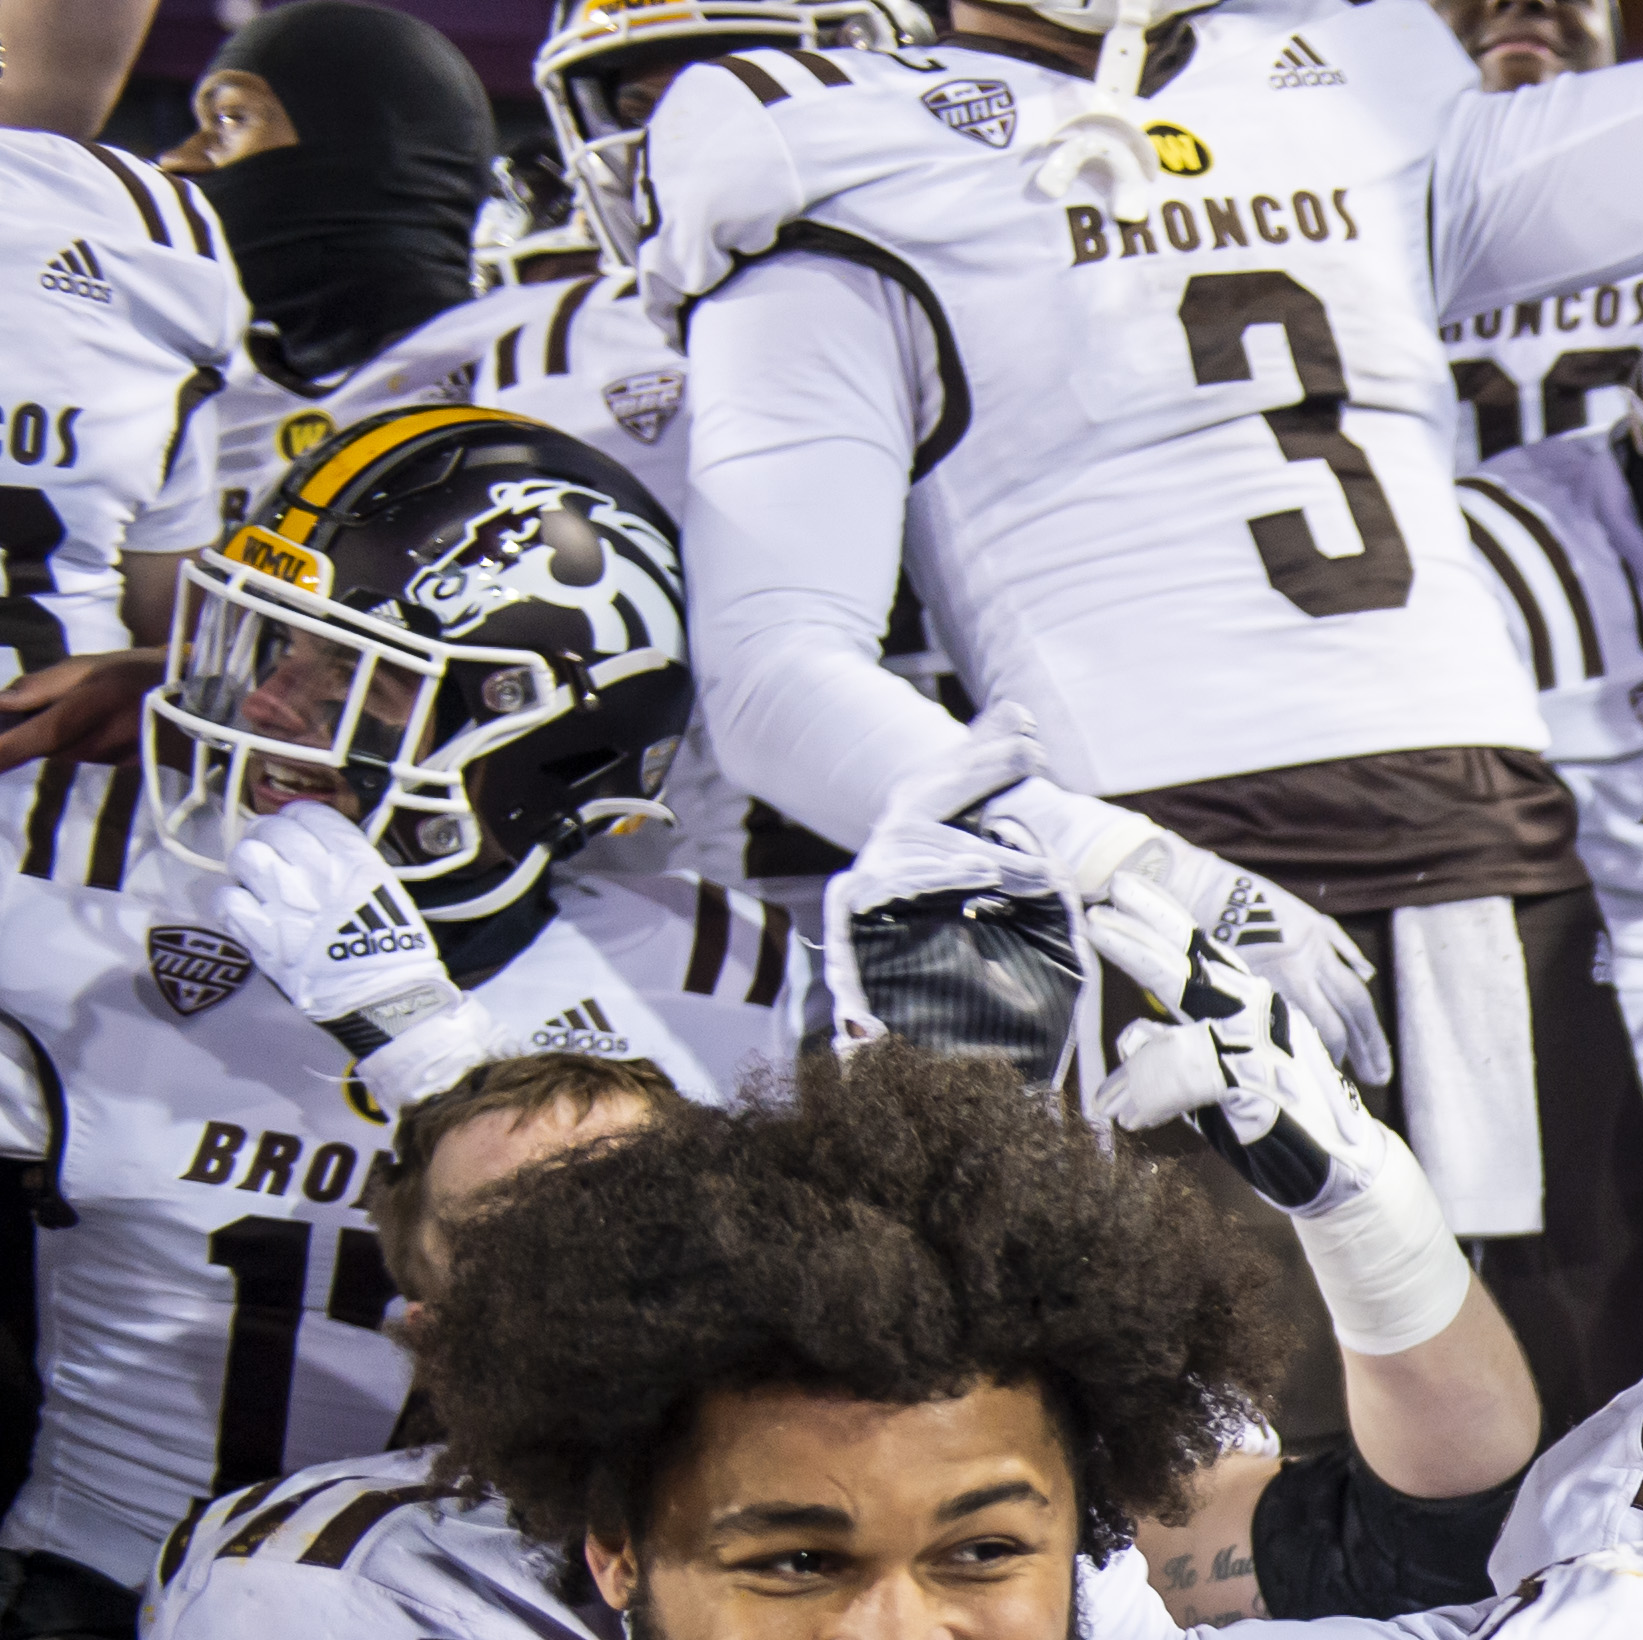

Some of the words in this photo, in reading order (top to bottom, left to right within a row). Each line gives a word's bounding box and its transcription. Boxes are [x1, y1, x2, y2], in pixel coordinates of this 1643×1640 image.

[1268, 66, 1346, 89] adidas
[1066, 188, 1359, 268] BRONCOS
[0, 402, 84, 468] OS
[1178, 270, 1415, 618] 3
[1213, 876, 1252, 941] adida
[153, 950, 243, 984] MAC
[327, 927, 427, 961] adidas
[531, 1026, 630, 1054] adidas
